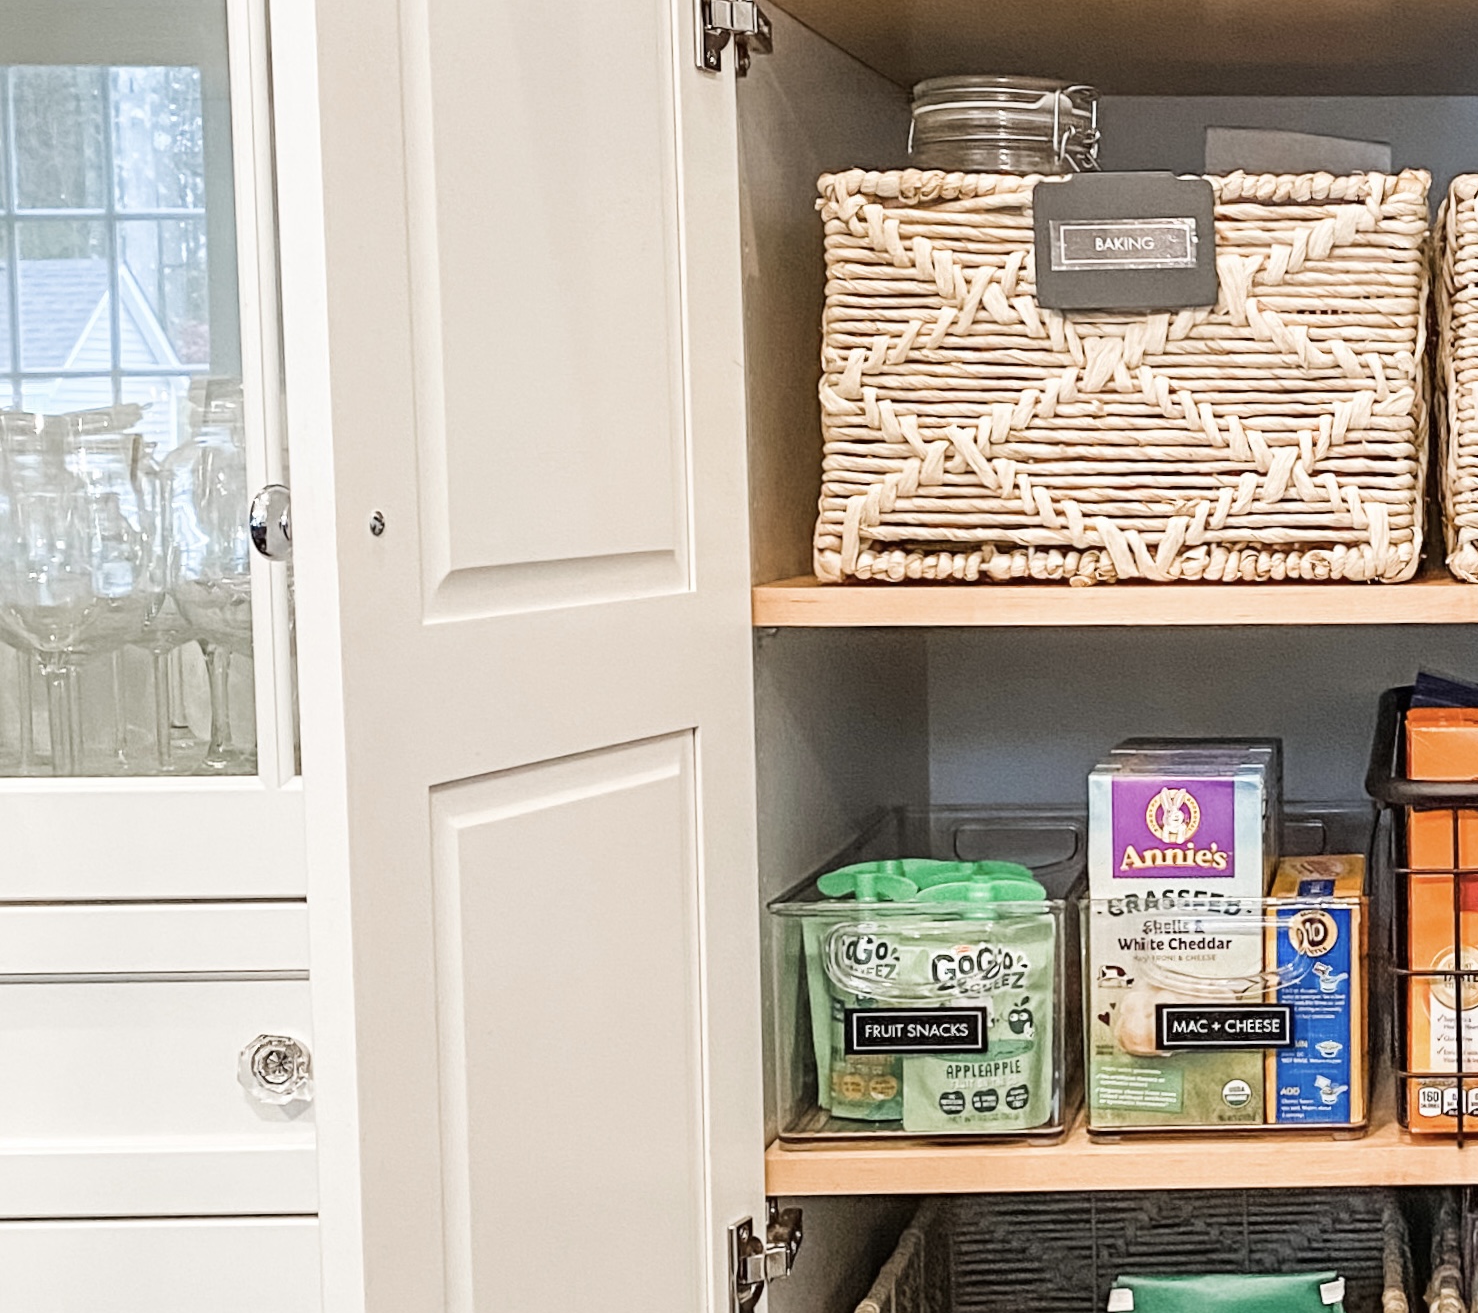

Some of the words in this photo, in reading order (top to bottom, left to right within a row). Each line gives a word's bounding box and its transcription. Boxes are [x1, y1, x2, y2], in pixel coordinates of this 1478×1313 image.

[1094, 236, 1156, 252] BAKING
[1120, 841, 1229, 871] Annie's
[1304, 921, 1325, 943] 10
[1117, 937, 1165, 951] White
[1168, 936, 1233, 951] Cheddar
[931, 946, 1014, 989] GoGo
[864, 1023, 904, 1038] FRUIT
[907, 1022, 970, 1038] SNACKS
[1171, 1018, 1209, 1034] MAC
[1212, 1020, 1222, 1032] +
[1224, 1017, 1281, 1034] CHEESE
[946, 1059, 1022, 1079] APPLEAPPLE
[1422, 1089, 1440, 1102] 160
